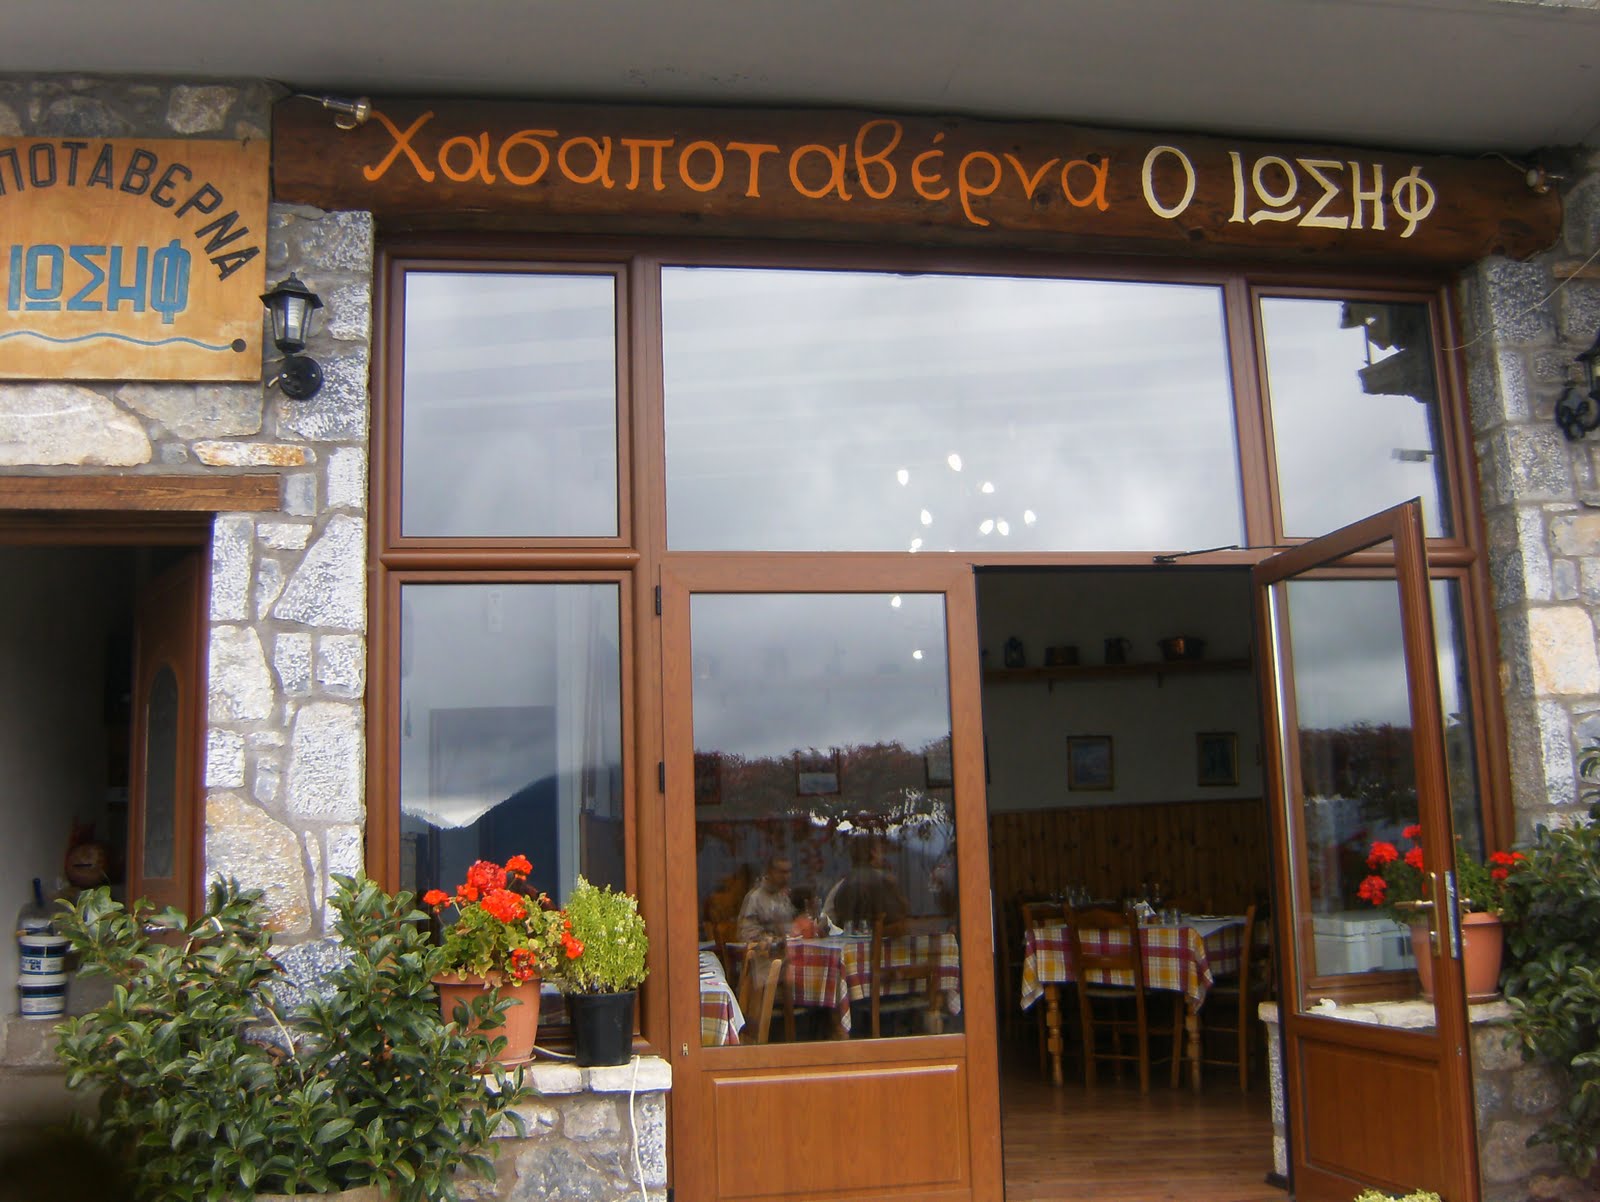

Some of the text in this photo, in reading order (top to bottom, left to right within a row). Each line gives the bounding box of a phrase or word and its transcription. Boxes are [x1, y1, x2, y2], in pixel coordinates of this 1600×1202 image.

[363, 111, 1436, 238] Χασαποταβέρνα Ο ΙΩΣΗΦ
[7, 238, 192, 325] ΙΩΣΗΦ
